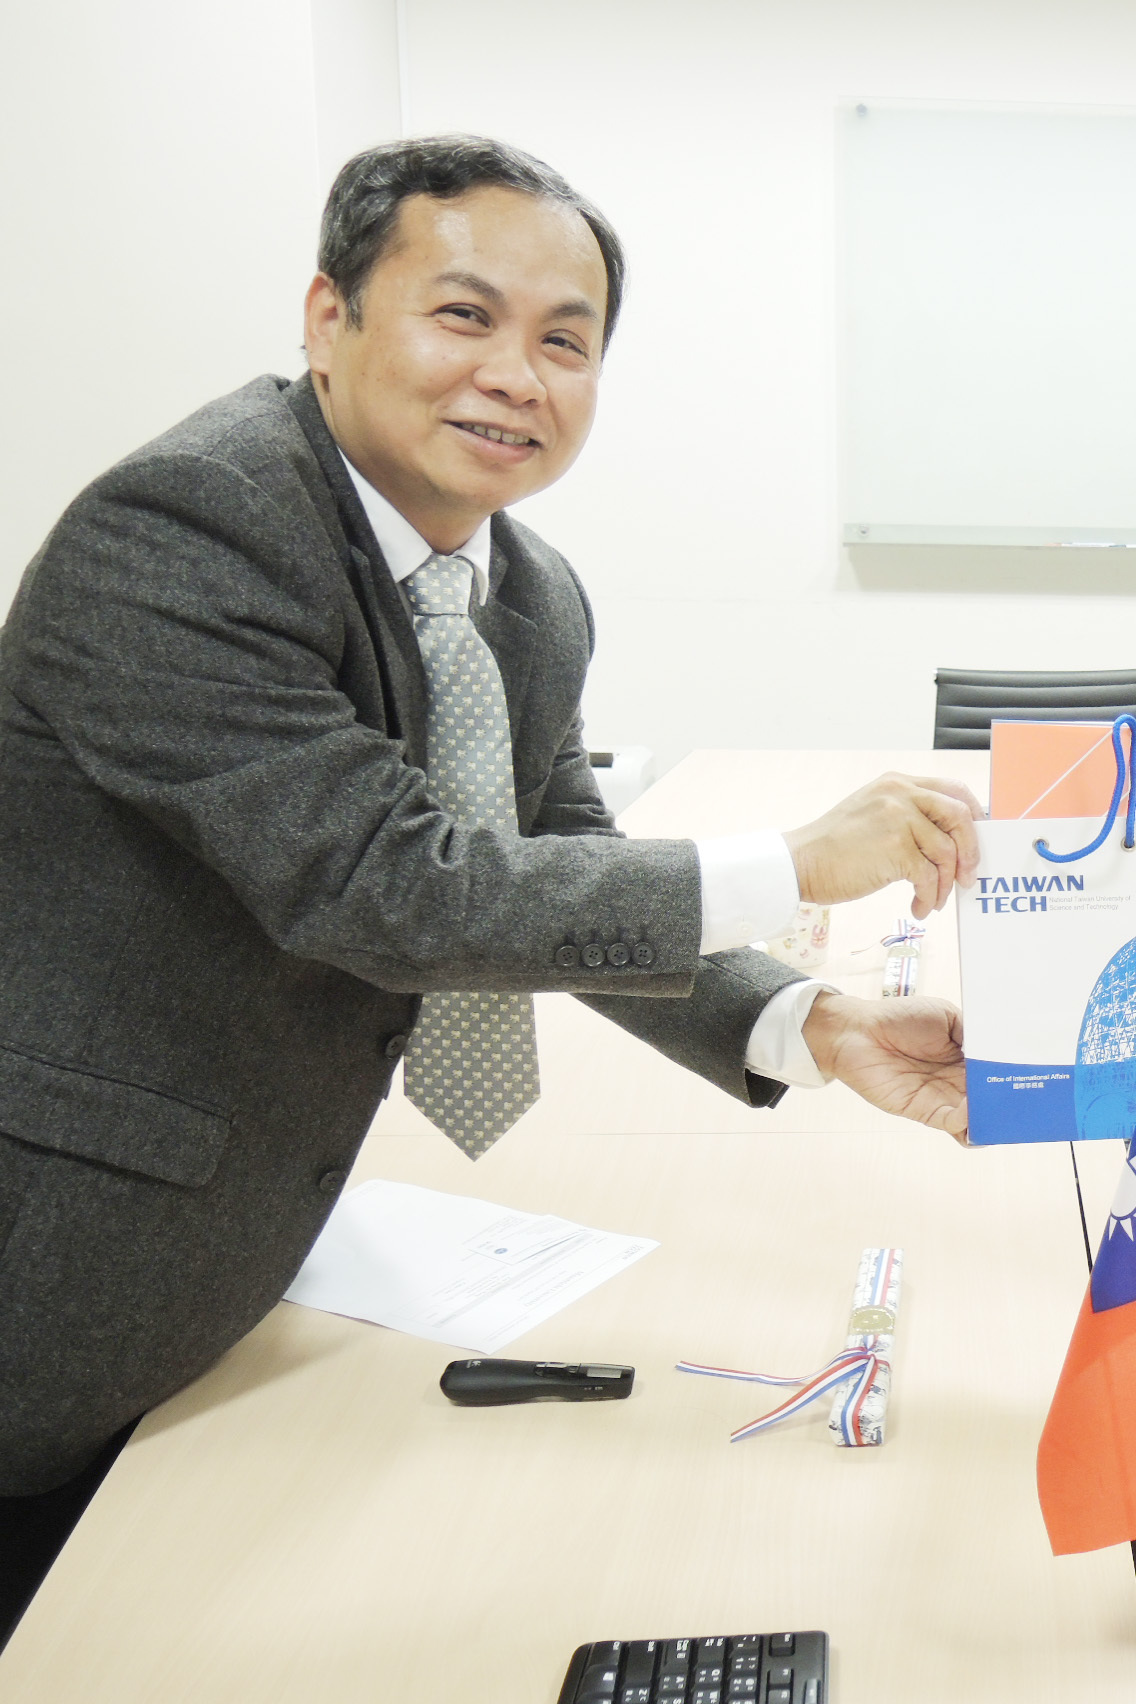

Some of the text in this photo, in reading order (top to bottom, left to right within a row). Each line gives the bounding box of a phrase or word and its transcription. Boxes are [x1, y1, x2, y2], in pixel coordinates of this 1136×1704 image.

[976, 874, 1084, 894] TAIWAN
[1049, 894, 1131, 904] National Taiwan University of
[975, 895, 1047, 914] TECH
[1049, 904, 1073, 912] Science
[1086, 903, 1119, 912] Technology
[1012, 1074, 1050, 1082] International
